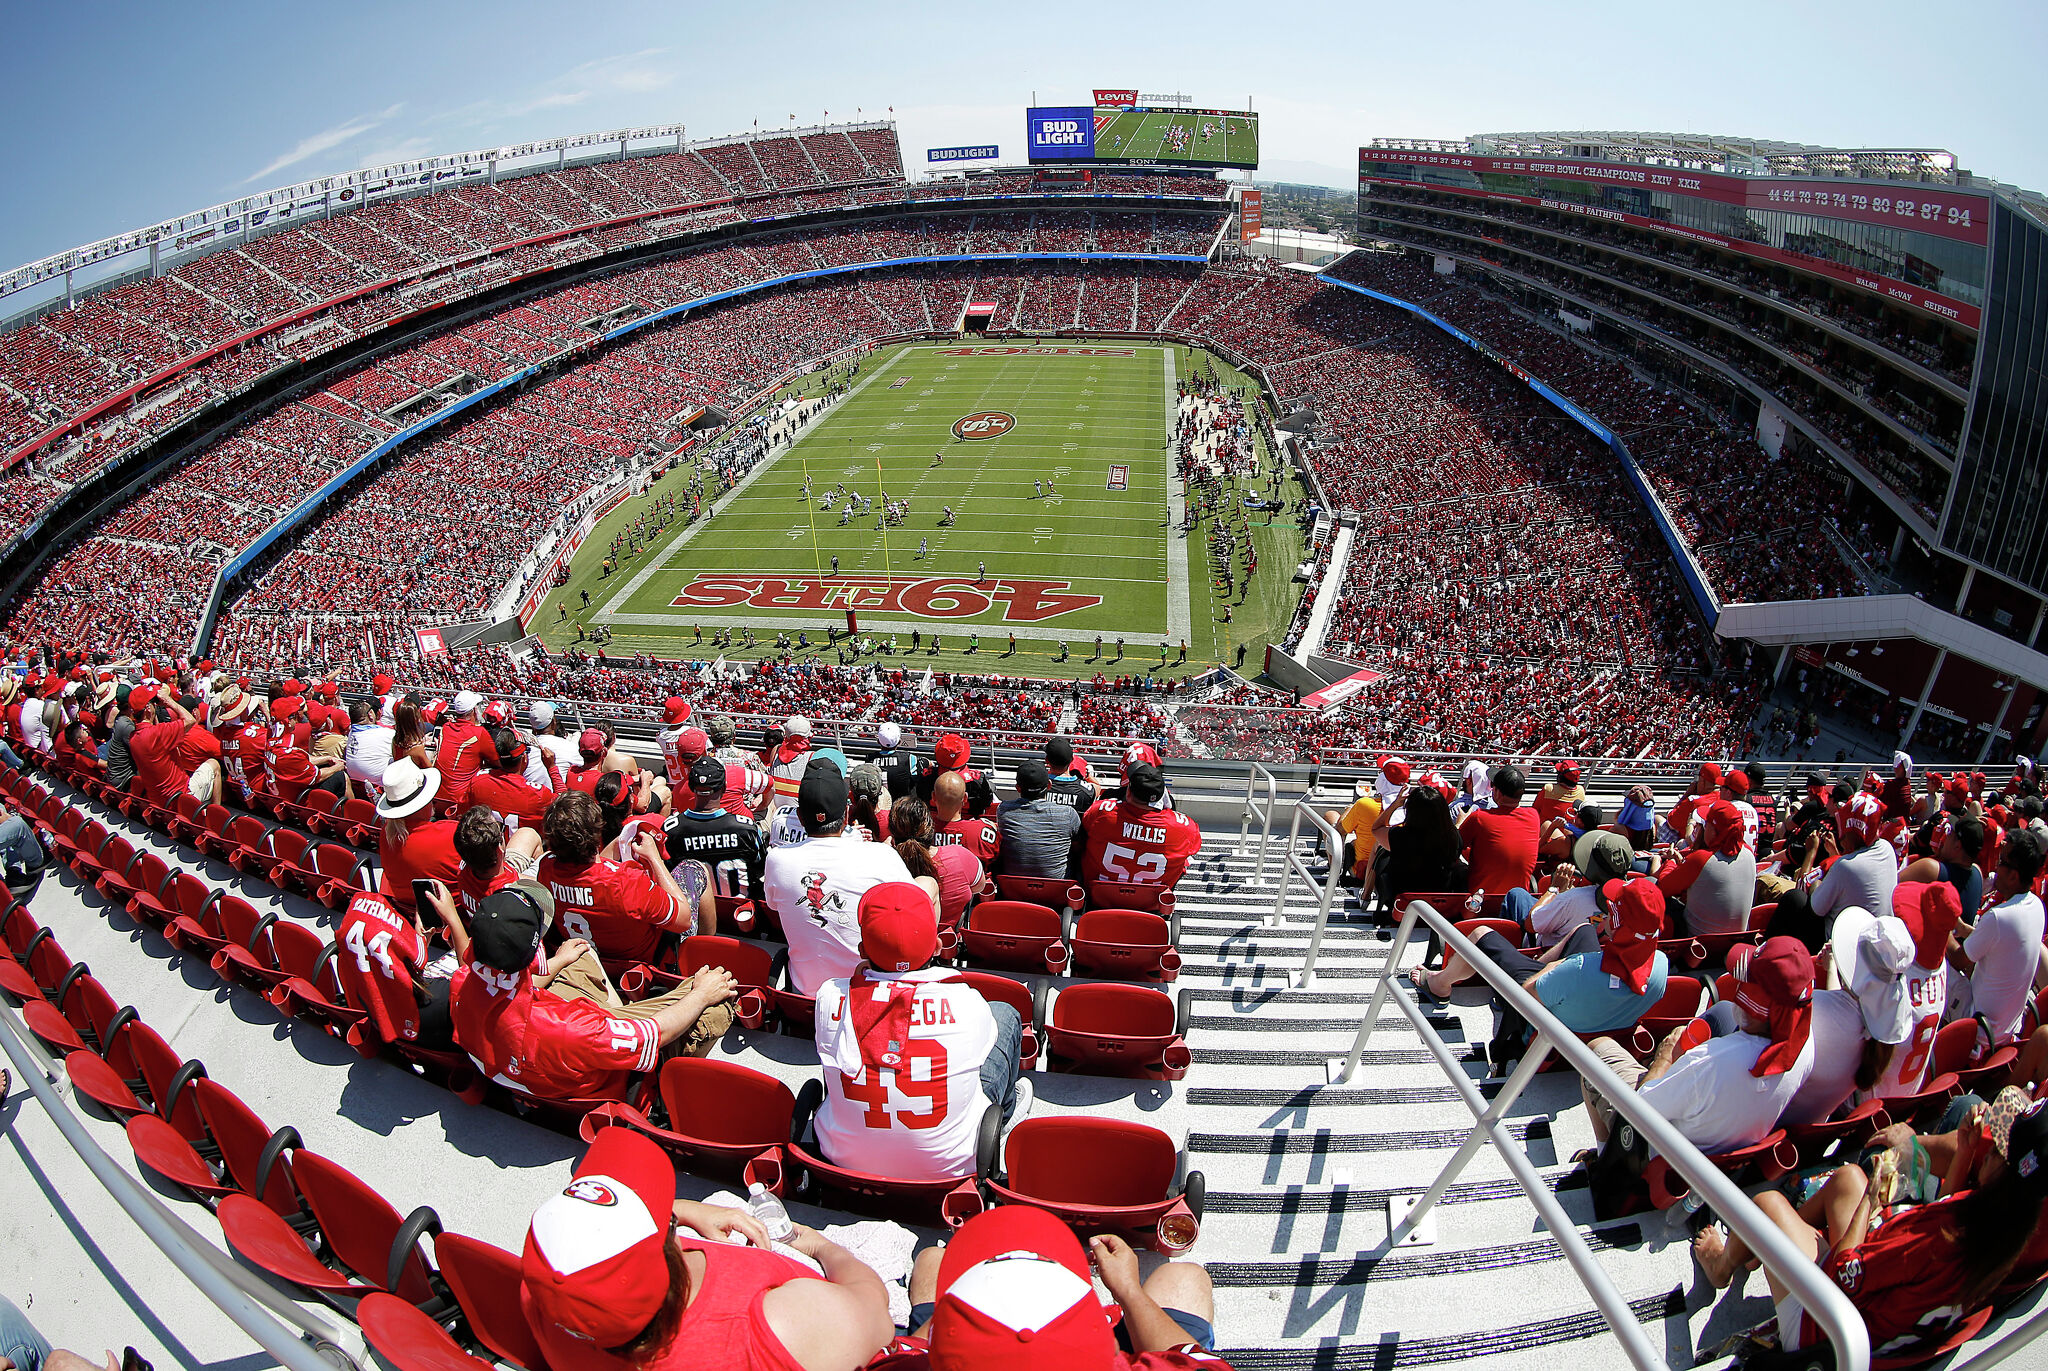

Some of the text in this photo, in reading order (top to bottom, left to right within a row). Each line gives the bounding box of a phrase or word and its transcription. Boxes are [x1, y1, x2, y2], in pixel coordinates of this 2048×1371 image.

[1141, 94, 1192, 103] STADIUM
[1042, 121, 1078, 133] BUD
[1036, 132, 1085, 145] LIGHT
[931, 147, 995, 160] BUDLIGHT
[1530, 163, 1556, 173] SUPER
[1556, 165, 1582, 176] BOWL
[1583, 168, 1646, 183] CHAMPIONS
[1650, 174, 1673, 186] XXIV
[1678, 178, 1700, 190] XXIX
[252, 213, 267, 225] SAP
[1540, 200, 1625, 222] HOME OF THE FAITHFUL
[1768, 188, 1780, 202] 44
[1799, 190, 1811, 204] 70
[1832, 193, 1847, 208] 74
[1851, 195, 1867, 210] 79
[1872, 197, 1891, 214] 80
[1895, 200, 1915, 218] 82
[1920, 203, 1942, 222] 87
[1947, 207, 1971, 228] 94
[225, 226, 239, 234] LIGHT
[1665, 226, 1696, 240] CONFERENCE
[1697, 234, 1729, 248] CHAMPIONS
[445, 294, 468, 305] WELCOME
[491, 279, 510, 290] STADIUM
[1855, 276, 1959, 320] WALSH McVAY SEIFERT
[304, 346, 334, 362] WELCOME
[364, 323, 389, 337] STADIUM
[80, 475, 99, 489] UNITED
[533, 563, 560, 606] FAITHFUL
[667, 573, 1104, 623] 49ERS
[1834, 661, 1863, 680] FRANKS
[222, 740, 240, 750] THOMAS
[684, 833, 738, 852] PEPPERS
[934, 833, 963, 846] RICE
[1122, 821, 1166, 844] WILLIS
[1098, 842, 1168, 886] 52
[550, 880, 594, 906] YOUNG
[352, 898, 404, 932] RATHMAN
[345, 920, 395, 980] 44
[840, 1039, 948, 1130] 49
